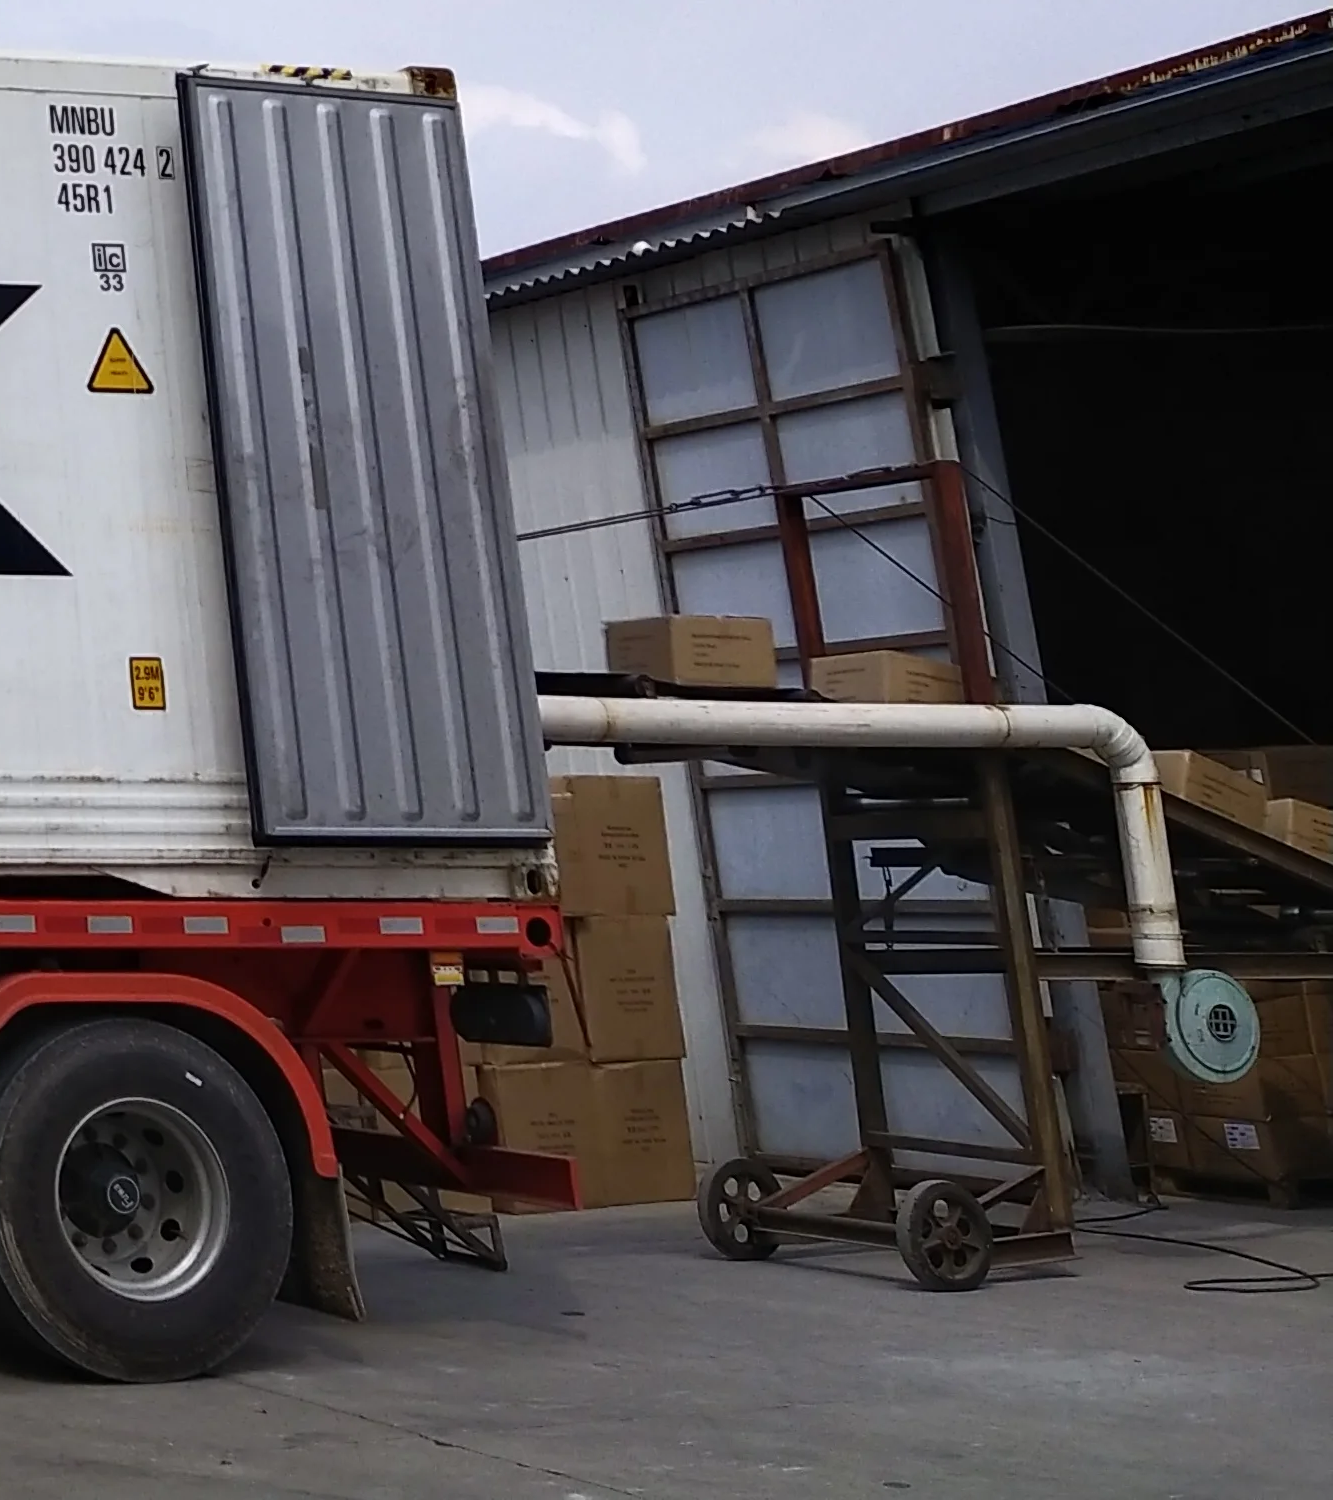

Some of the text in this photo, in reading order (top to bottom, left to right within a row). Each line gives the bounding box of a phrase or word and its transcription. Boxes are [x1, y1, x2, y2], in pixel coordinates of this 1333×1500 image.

[49, 104, 115, 137] MNBU
[52, 143, 174, 179] 390 424 2
[57, 182, 113, 214] 45R1
[99, 273, 124, 292] 33
